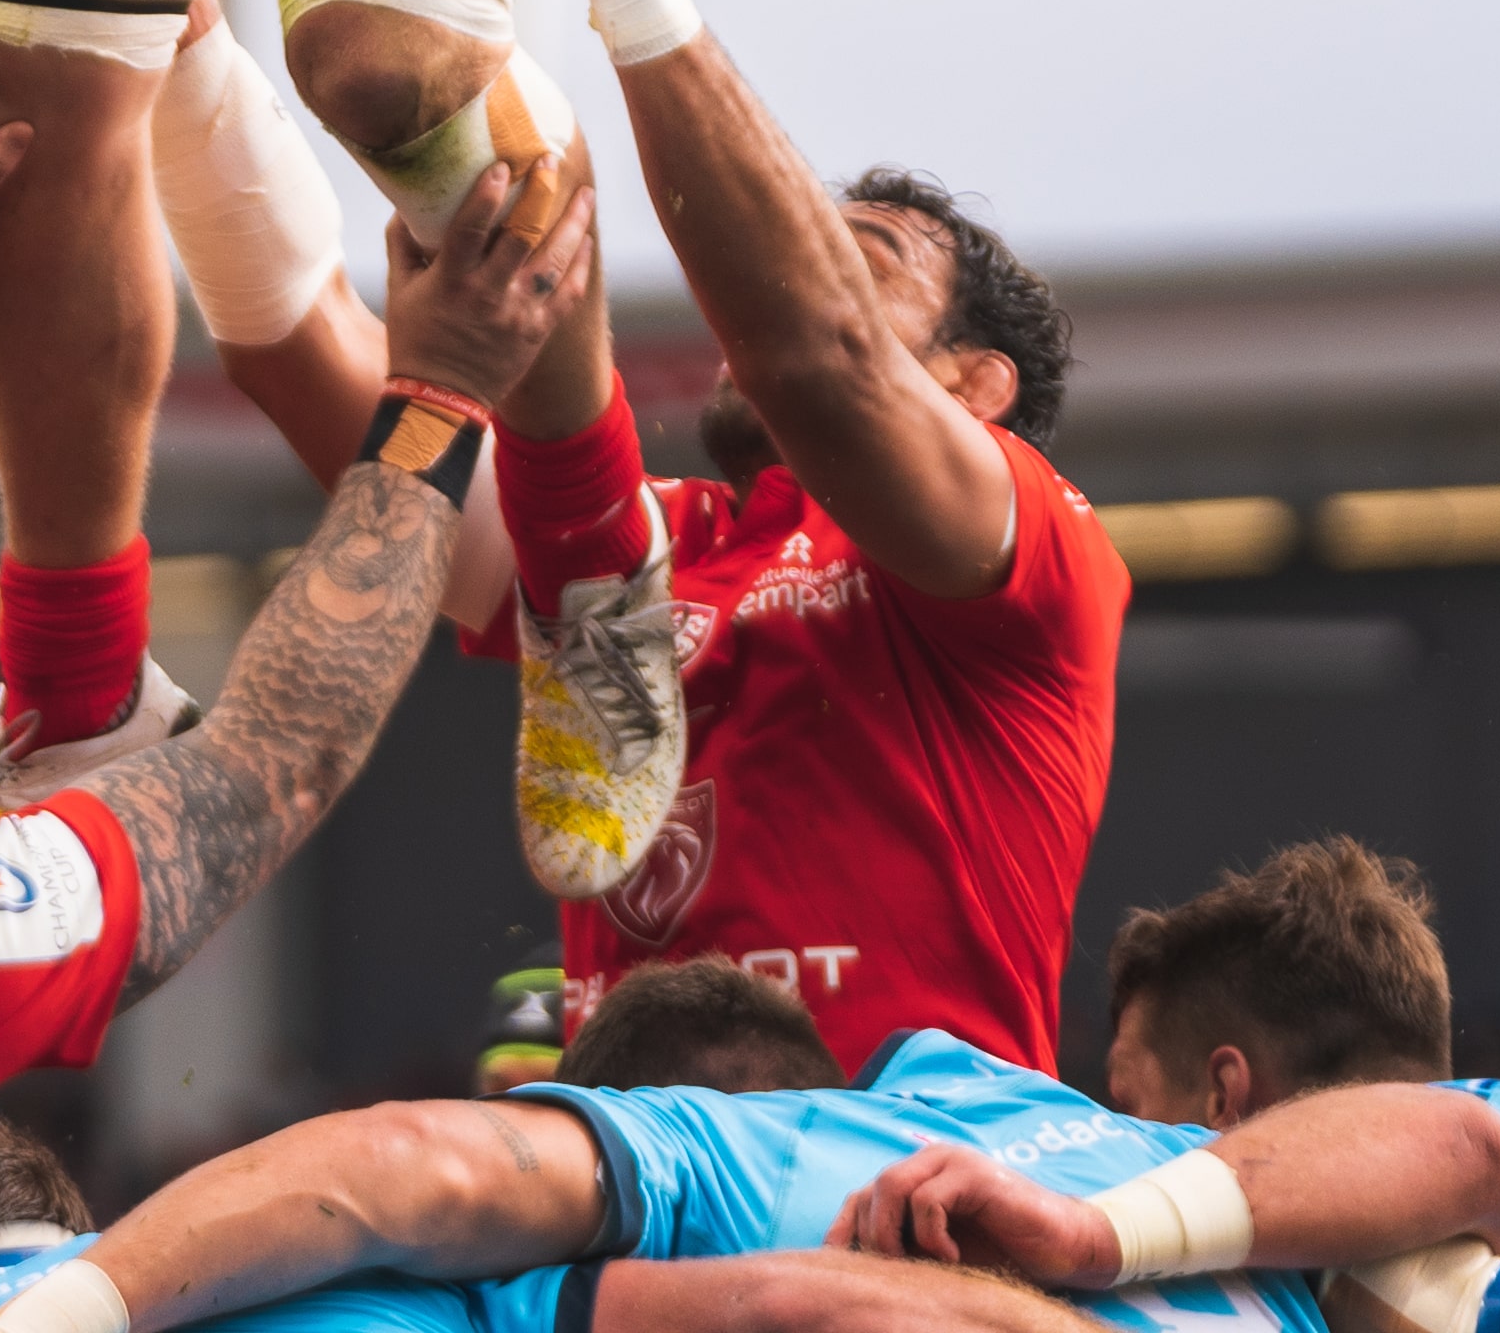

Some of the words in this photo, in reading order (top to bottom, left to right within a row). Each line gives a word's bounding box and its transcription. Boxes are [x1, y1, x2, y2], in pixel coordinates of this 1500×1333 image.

[731, 565, 871, 625] empart
[753, 564, 825, 588] utuelle
[50, 847, 81, 895] CUP
